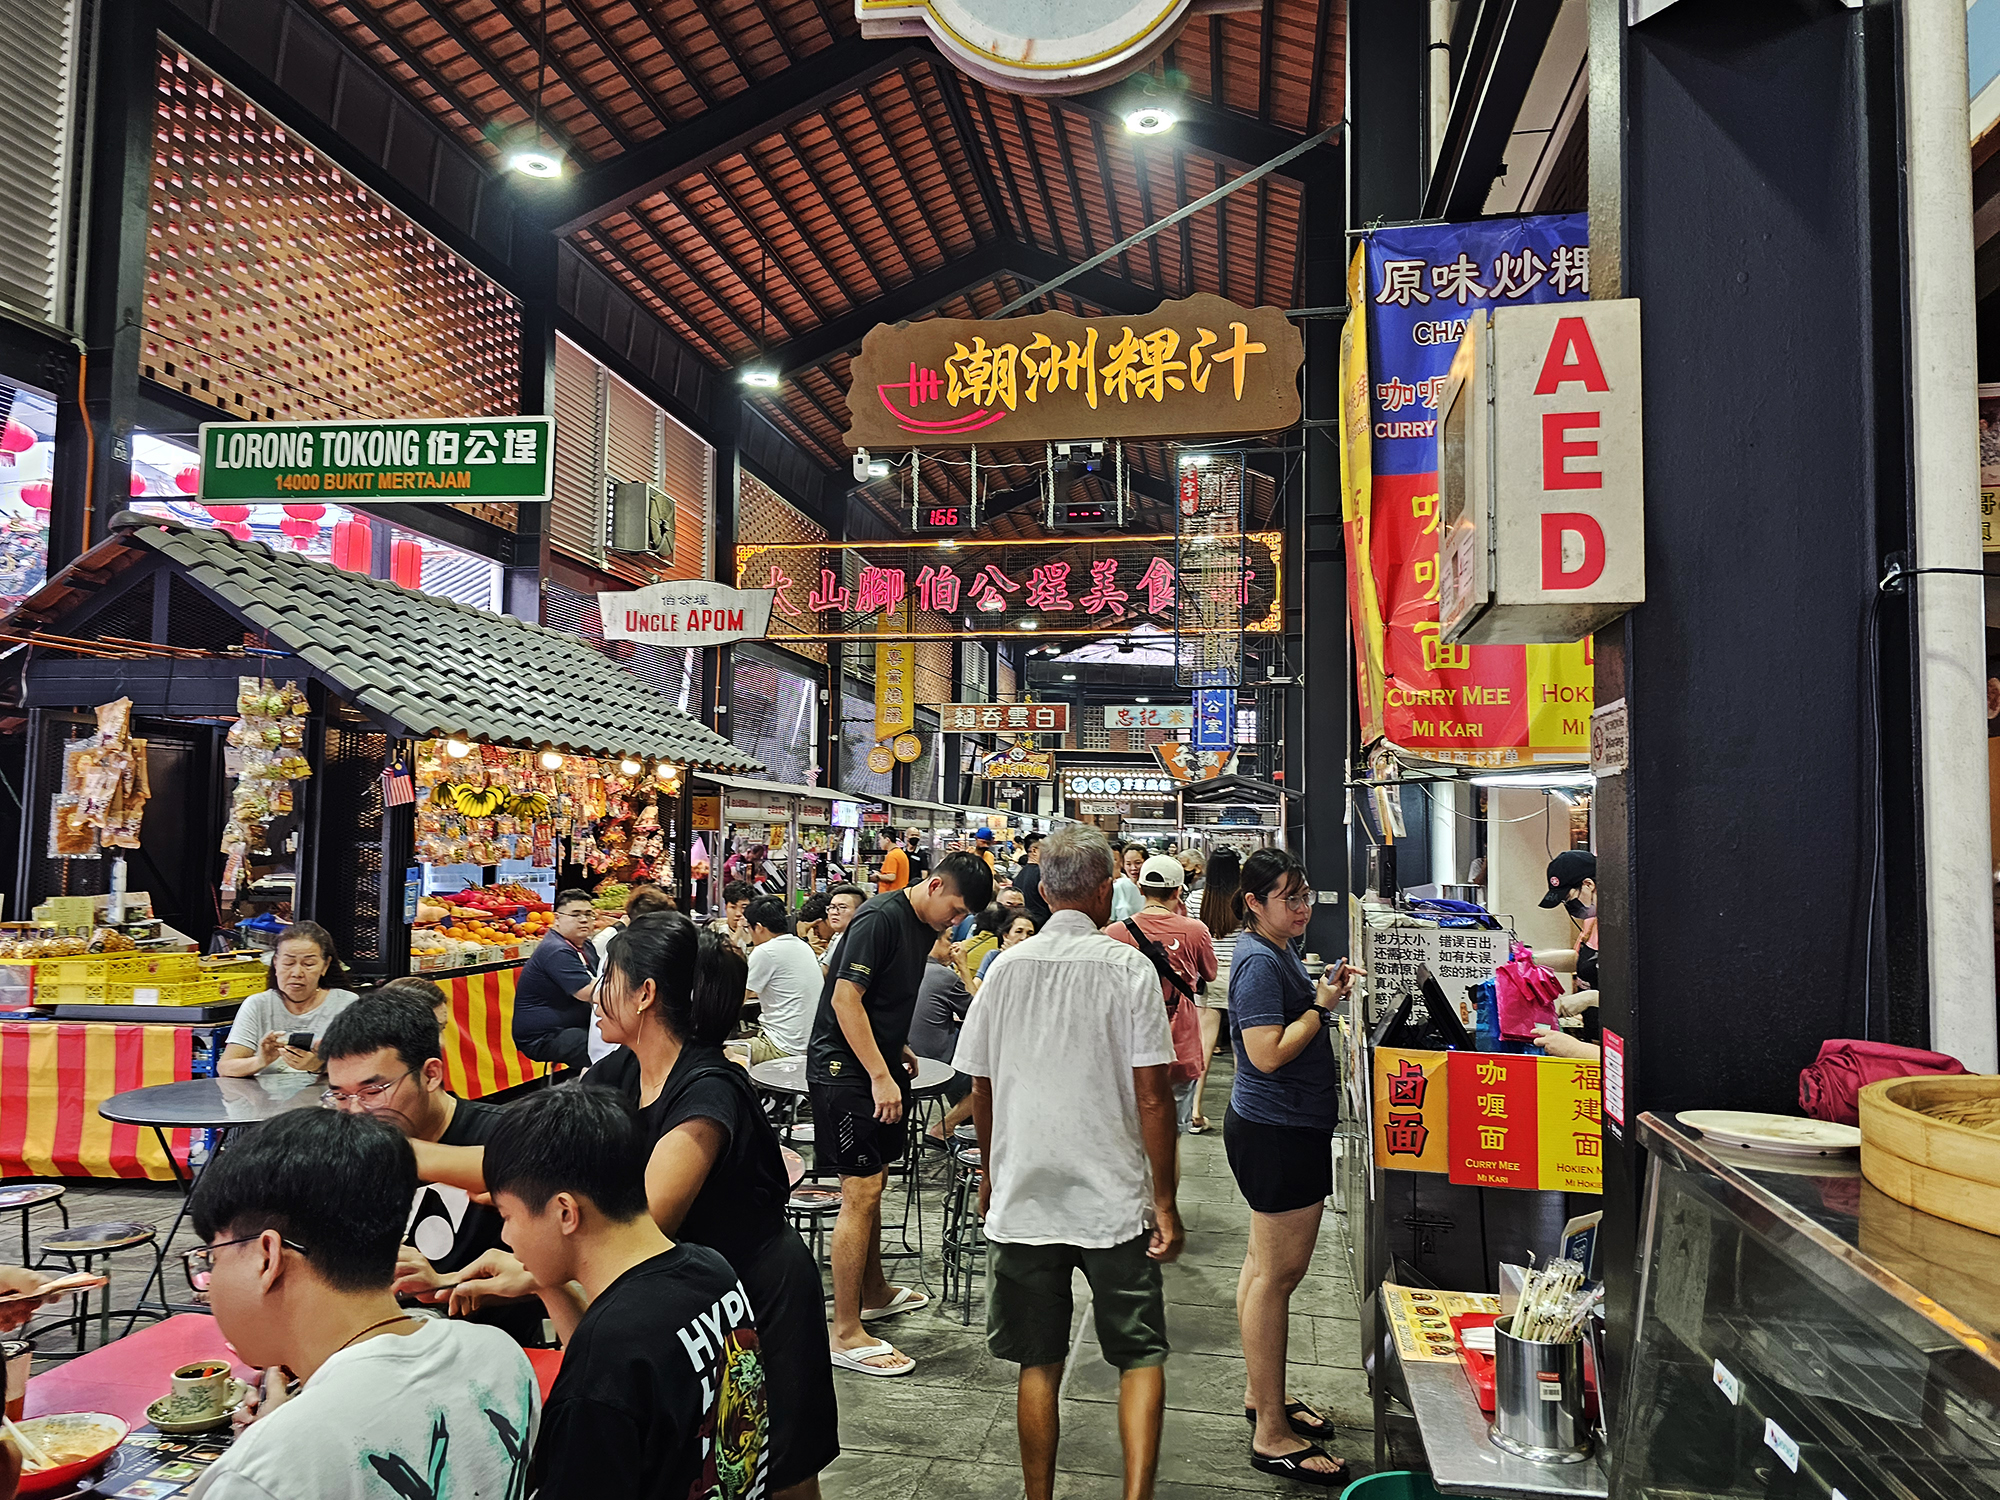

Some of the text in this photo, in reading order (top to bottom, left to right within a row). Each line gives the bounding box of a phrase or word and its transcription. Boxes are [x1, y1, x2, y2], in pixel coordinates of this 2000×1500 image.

[944, 321, 1267, 411] 潮洲粿汁
[1375, 421, 1437, 439] CURRY
[215, 428, 537, 469] LORONG TOKONG 伯公埕
[1533, 316, 1610, 591] AED
[275, 471, 471, 491] 14000 BUKIT MERTAJAM
[929, 508, 959, 526] 166
[625, 609, 744, 632] UNCLE APOM
[1387, 686, 1511, 708] CURRY MEE
[1412, 720, 1483, 737] MI KARI
[1384, 1058, 1430, 1158] 卤面
[1476, 1060, 1509, 1151] 咖喱面
[1571, 1064, 1602, 1157] 福建面
[1465, 1158, 1520, 1172] CURRY MEE
[1556, 1163, 1595, 1176] HOKIEN
[1477, 1173, 1509, 1184] MI KARI
